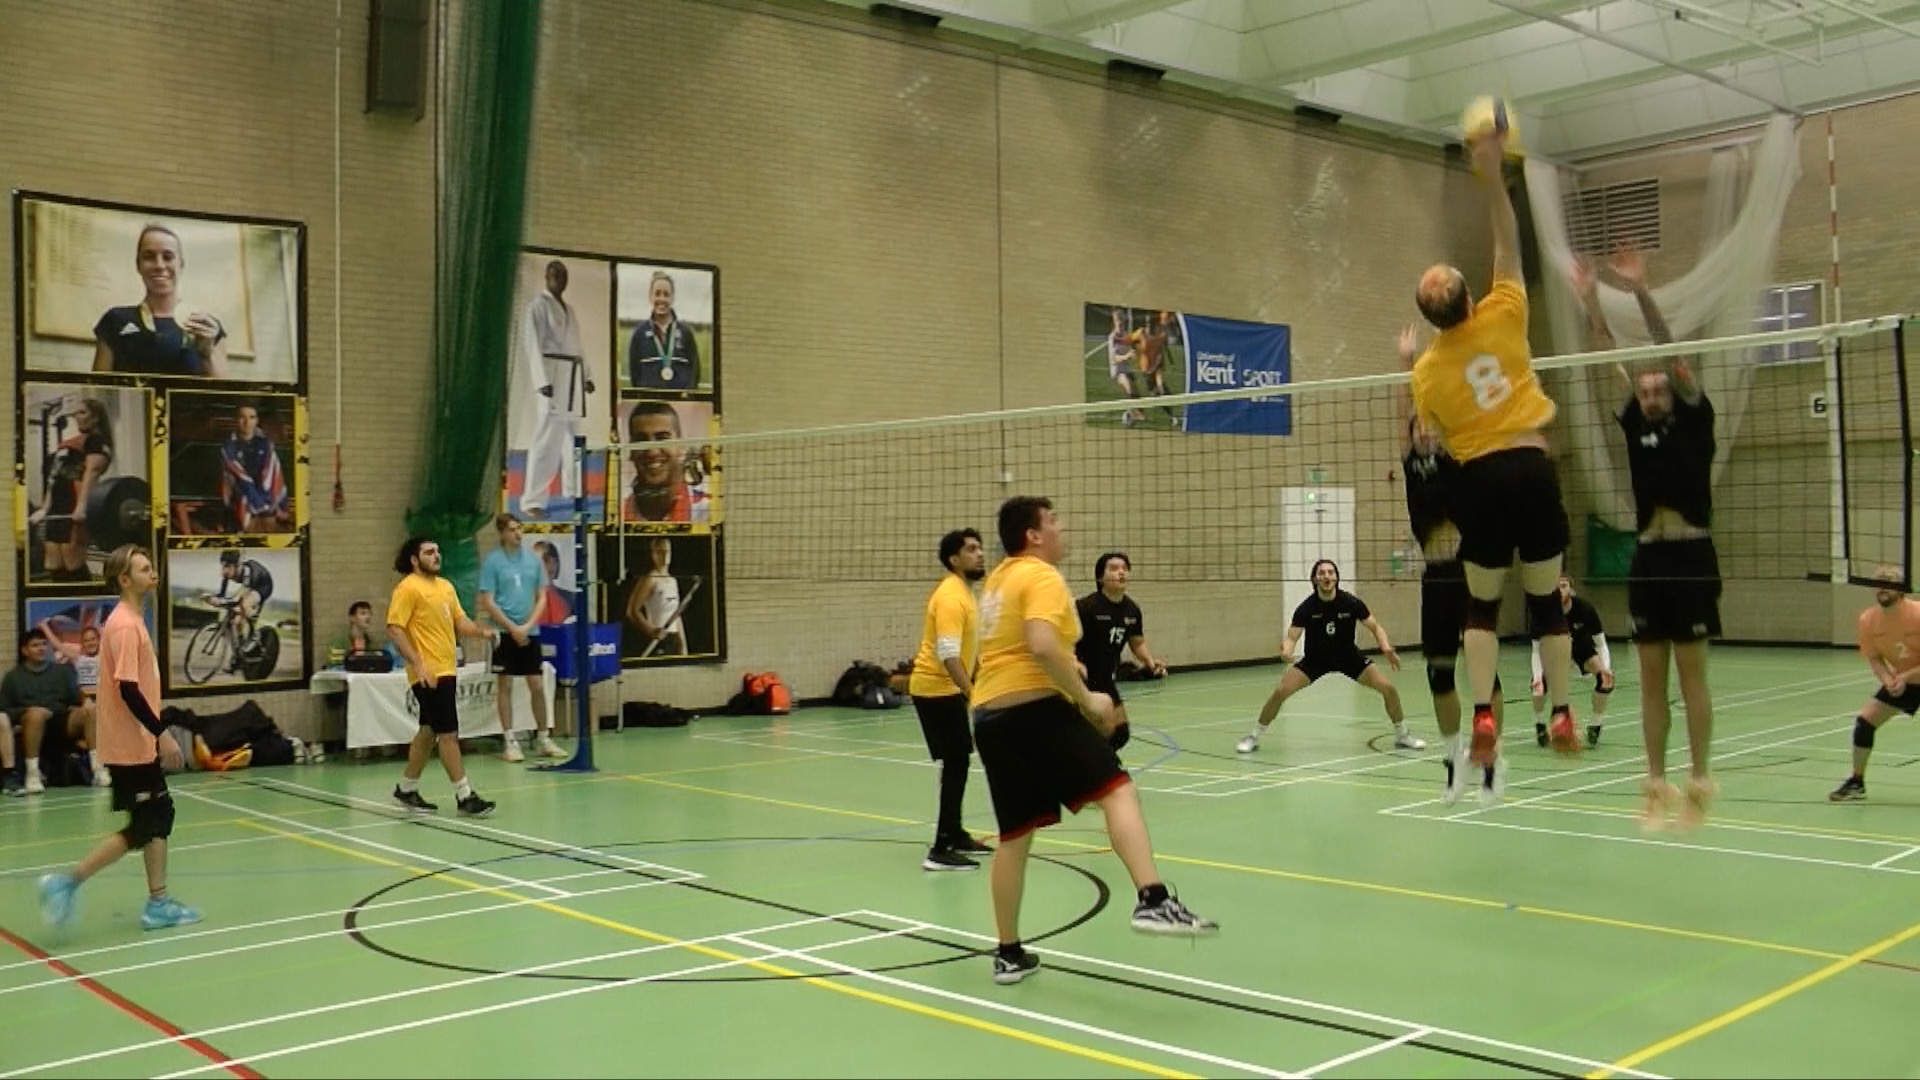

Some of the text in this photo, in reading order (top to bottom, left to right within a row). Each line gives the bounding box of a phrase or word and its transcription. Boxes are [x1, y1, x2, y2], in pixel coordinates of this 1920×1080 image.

[1196, 361, 1236, 385] Kent
[1464, 353, 1512, 411] 8
[1814, 398, 1826, 414] 6
[1109, 626, 1126, 645] 15
[1325, 621, 1336, 635] 6
[1895, 643, 1909, 658] 2
